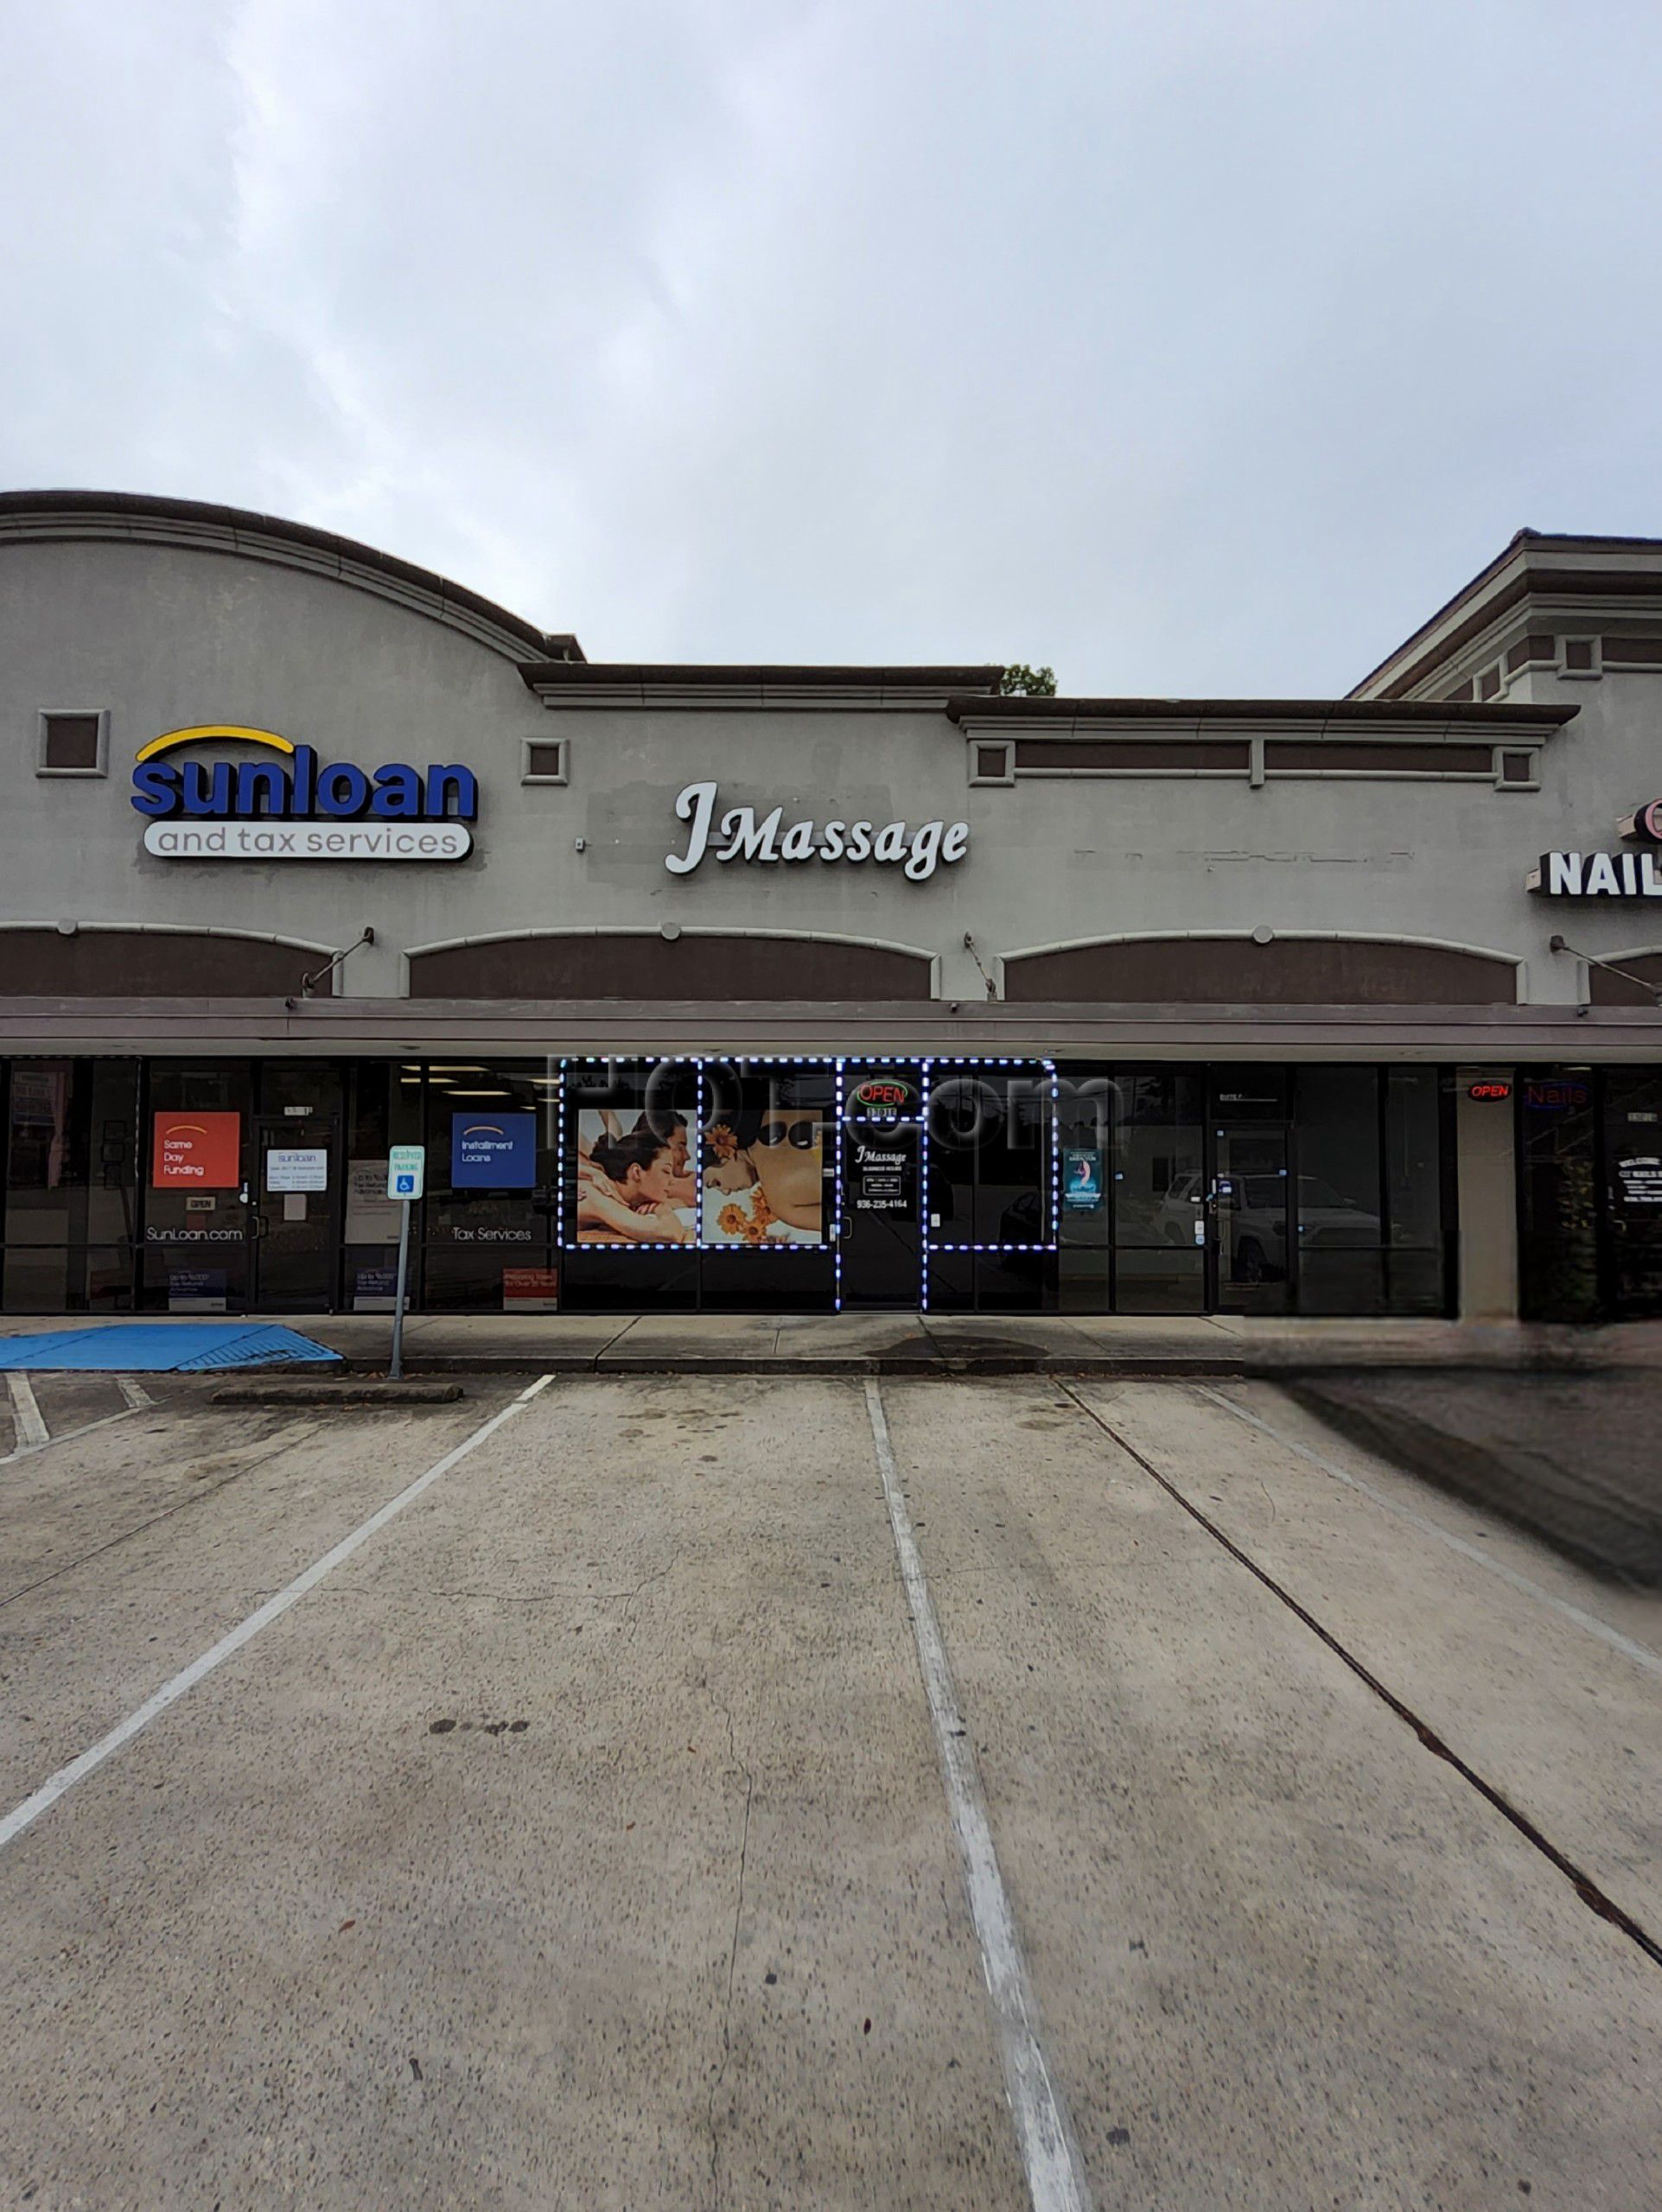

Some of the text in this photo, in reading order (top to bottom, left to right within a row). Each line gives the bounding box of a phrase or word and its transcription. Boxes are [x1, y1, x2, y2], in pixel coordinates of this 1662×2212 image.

[131, 745, 477, 817] sunloan
[665, 781, 970, 880] J Massage
[158, 826, 457, 855] and tax services
[860, 1084, 905, 1103] OPEN
[1471, 1085, 1508, 1097] OPEN
[1527, 1085, 1588, 1103] Nails
[164, 1140, 193, 1149] Same
[462, 1141, 513, 1150] Installment
[164, 1152, 184, 1164] Day
[462, 1153, 491, 1162] Loans
[864, 1151, 907, 1166] Massage
[164, 1165, 205, 1176] Funding
[191, 1200, 212, 1209] OPEN
[146, 1227, 243, 1241] SunLoan.com
[452, 1227, 532, 1240] Tax Services
